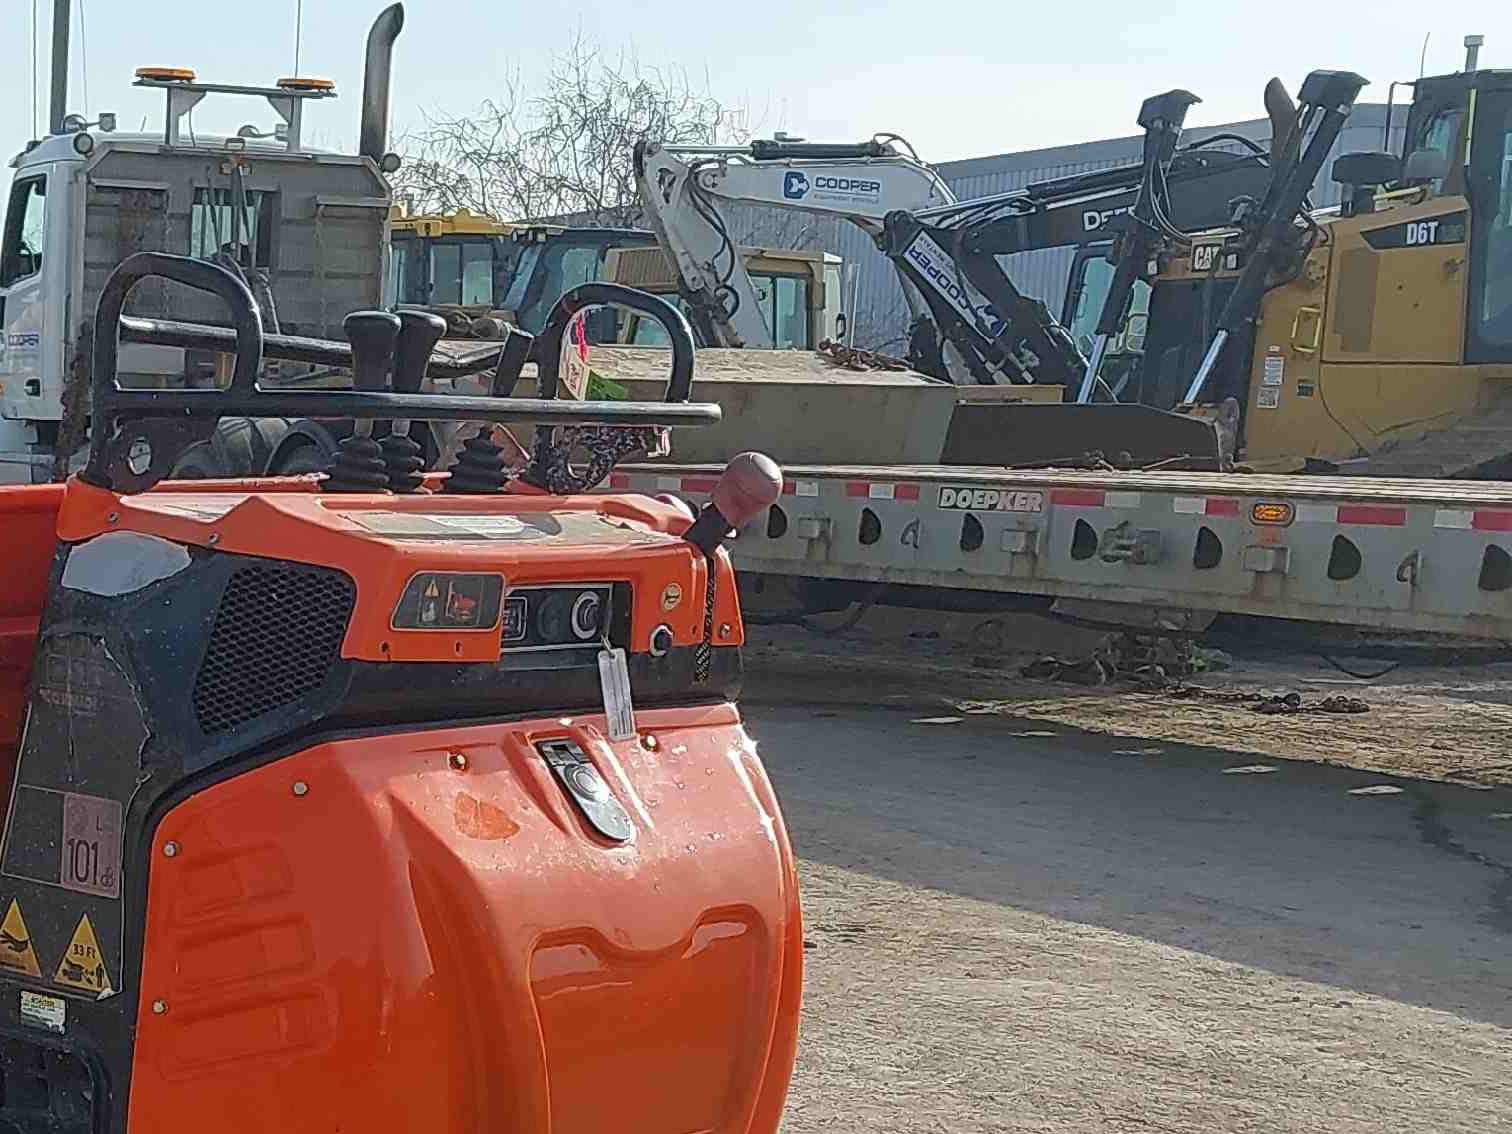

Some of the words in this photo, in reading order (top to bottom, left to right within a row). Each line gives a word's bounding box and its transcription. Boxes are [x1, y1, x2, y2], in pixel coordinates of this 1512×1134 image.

[815, 176, 881, 193] COOPER
[1406, 221, 1439, 245] D6T
[939, 488, 1042, 511] DOEPKER
[66, 837, 100, 887] 101
